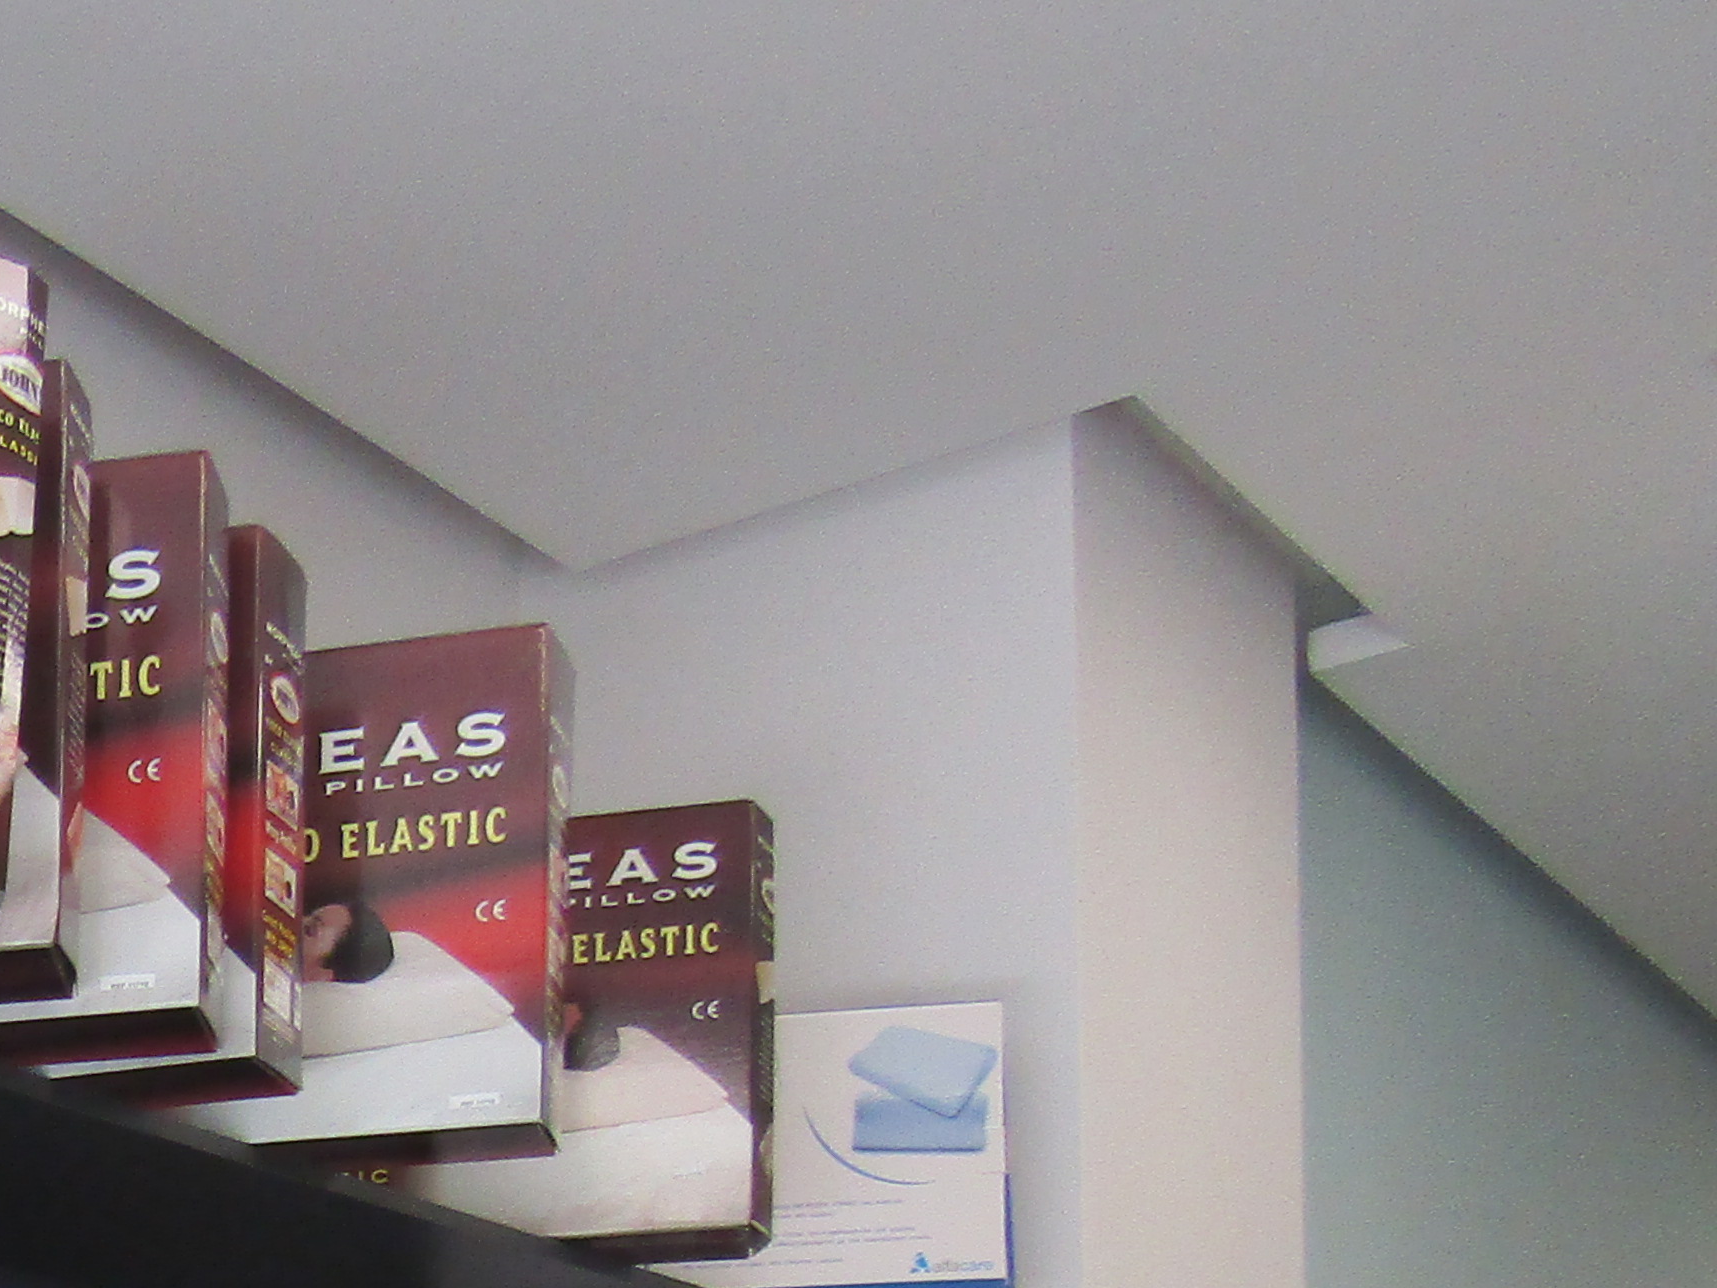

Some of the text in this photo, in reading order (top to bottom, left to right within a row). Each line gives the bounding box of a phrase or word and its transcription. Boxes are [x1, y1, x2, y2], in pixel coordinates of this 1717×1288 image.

[324, 759, 505, 796] PILLOW
[340, 805, 509, 861] ELASTIC
[572, 921, 721, 965] ELASTIC
